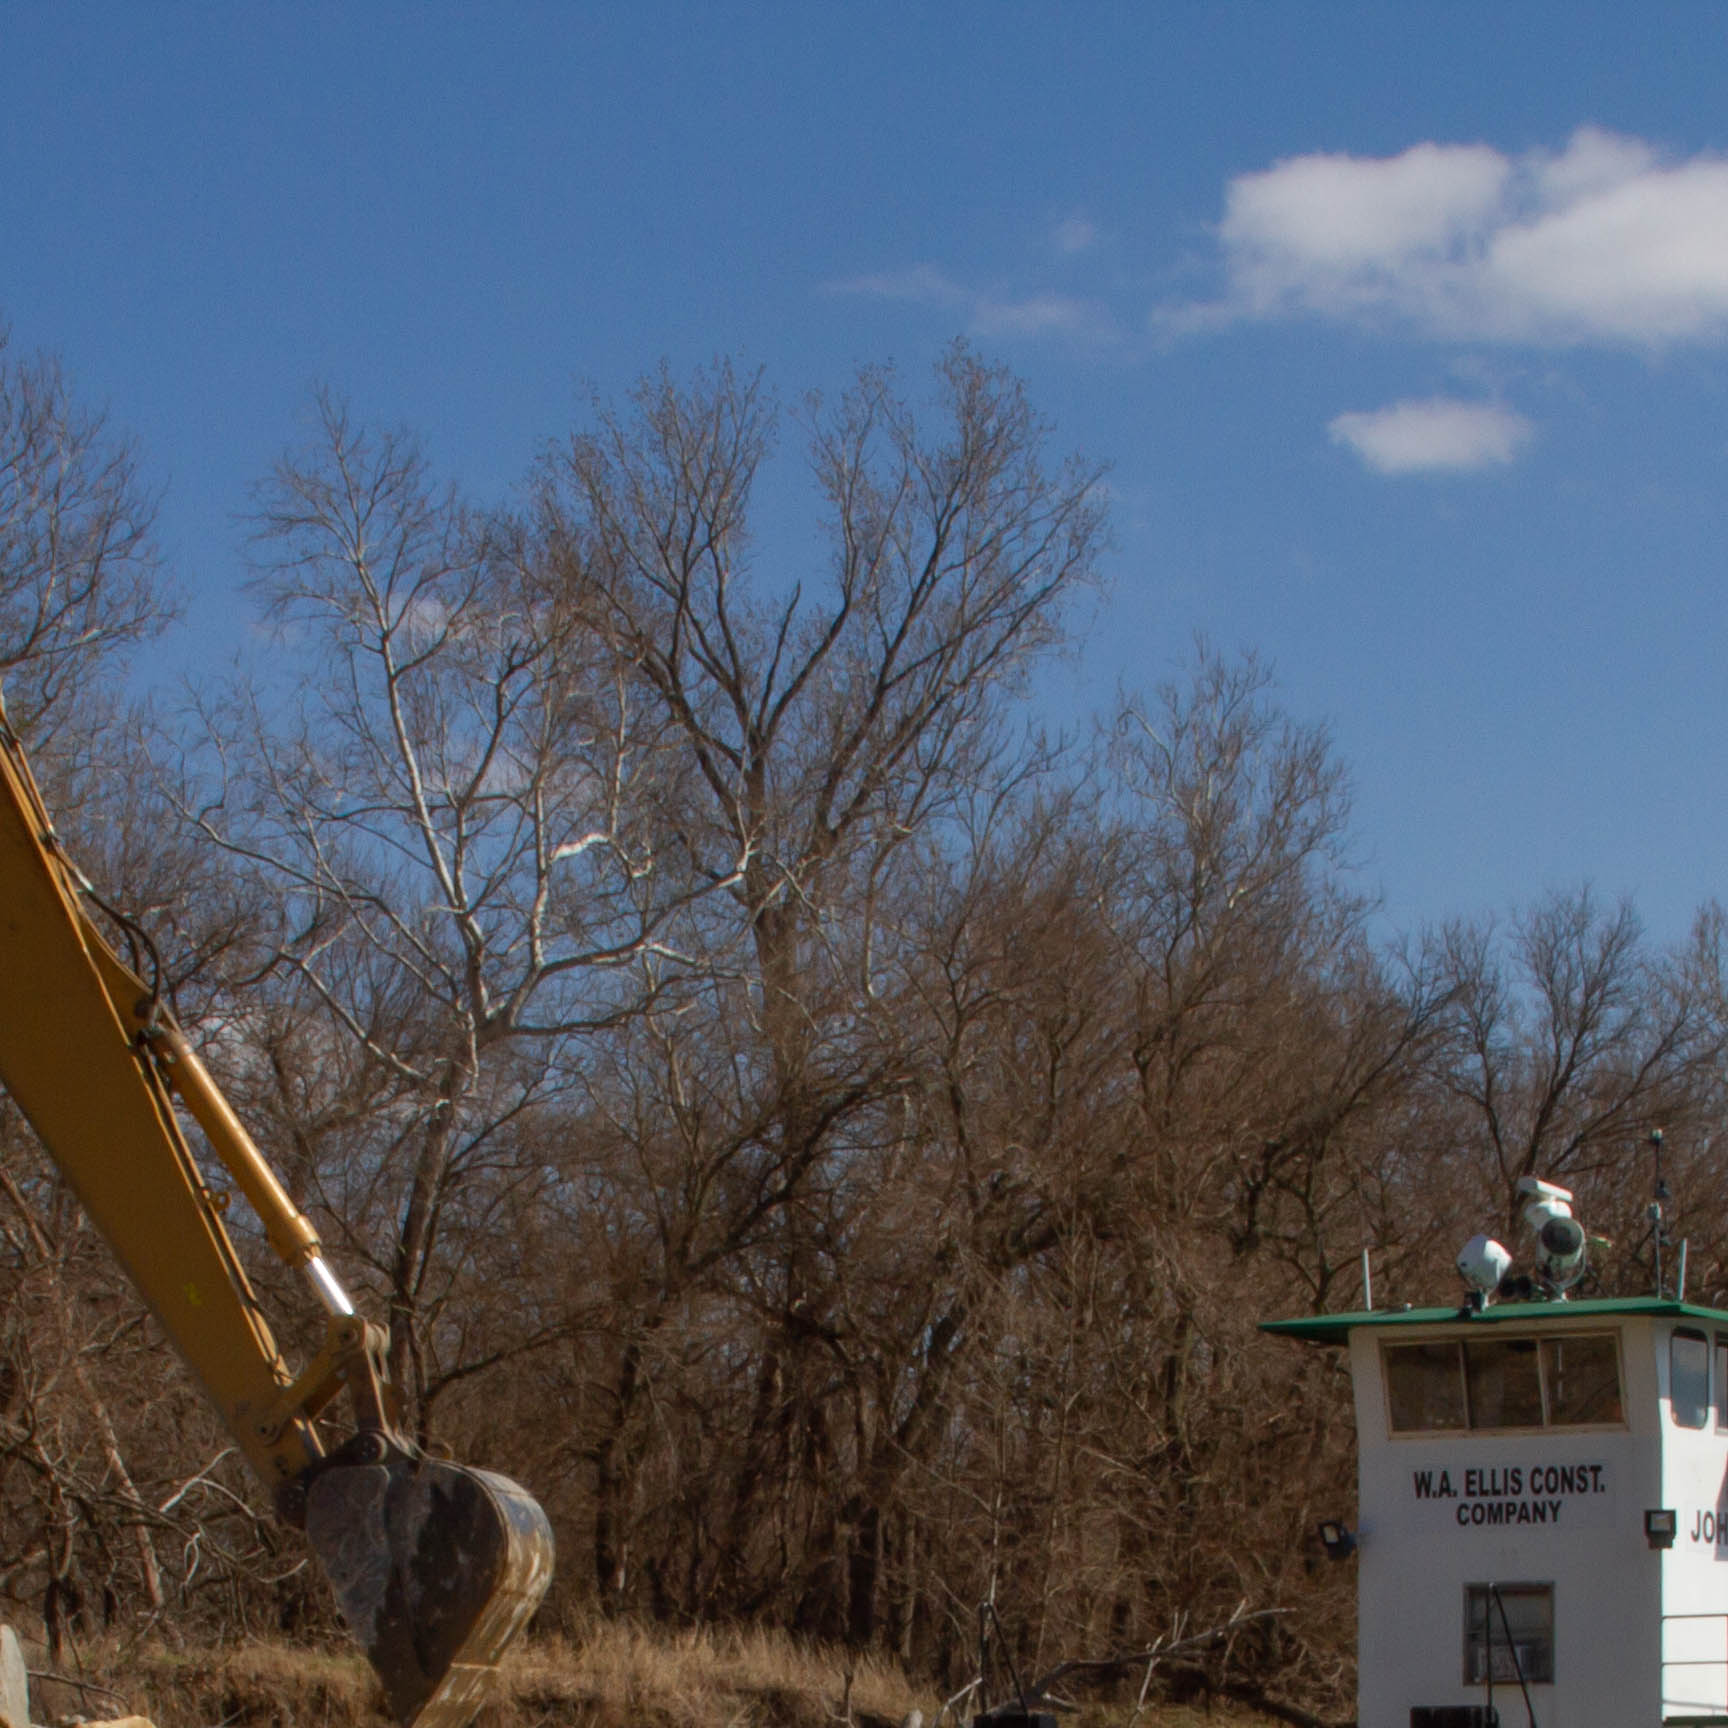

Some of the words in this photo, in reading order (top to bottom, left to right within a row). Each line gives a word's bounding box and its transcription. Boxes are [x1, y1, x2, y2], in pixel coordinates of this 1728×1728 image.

[1414, 1470, 1458, 1499] W.A.
[1465, 1467, 1523, 1497] ELLIS
[1530, 1464, 1606, 1494] CONST.
[1456, 1500, 1562, 1526] COMPANY
